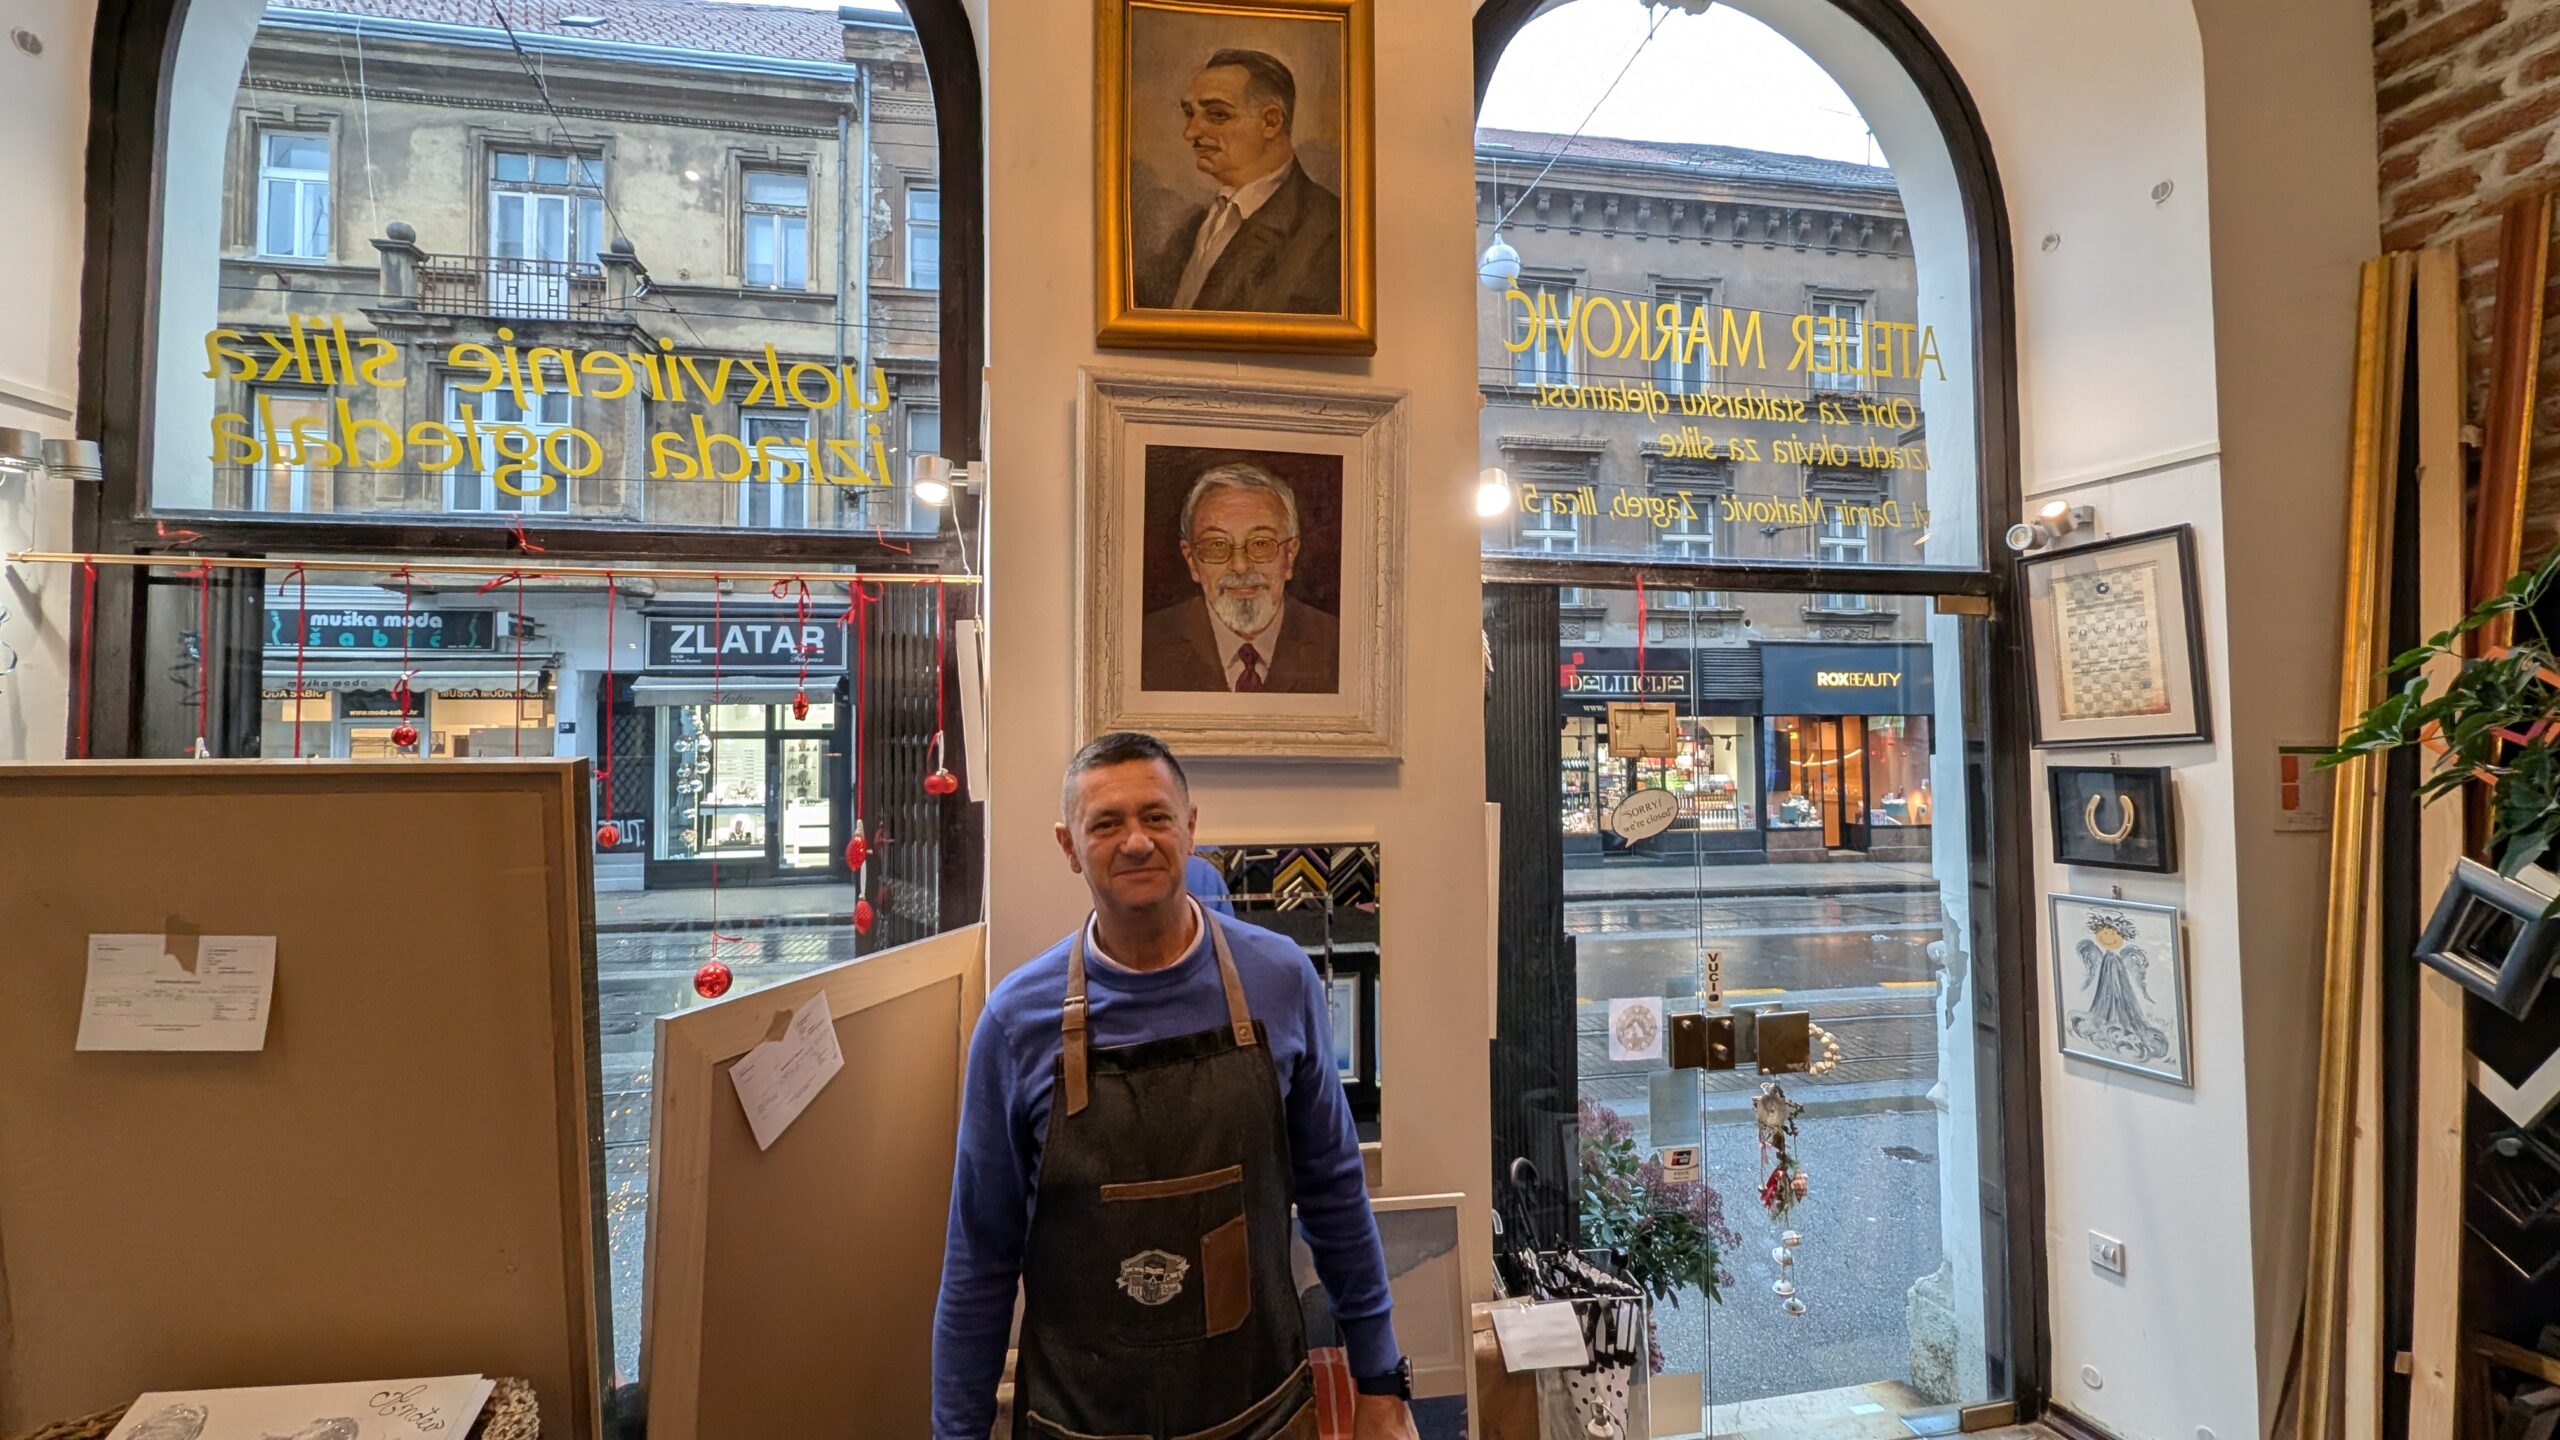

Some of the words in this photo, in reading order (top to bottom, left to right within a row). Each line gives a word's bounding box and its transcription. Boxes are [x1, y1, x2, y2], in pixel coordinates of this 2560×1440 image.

[310, 610, 377, 627] muška
[383, 612, 443, 628] moda
[670, 625, 825, 654] ZLATAR
[1816, 671, 1902, 687] ROXBEAUTY
[1707, 952, 1719, 992] VUCI
